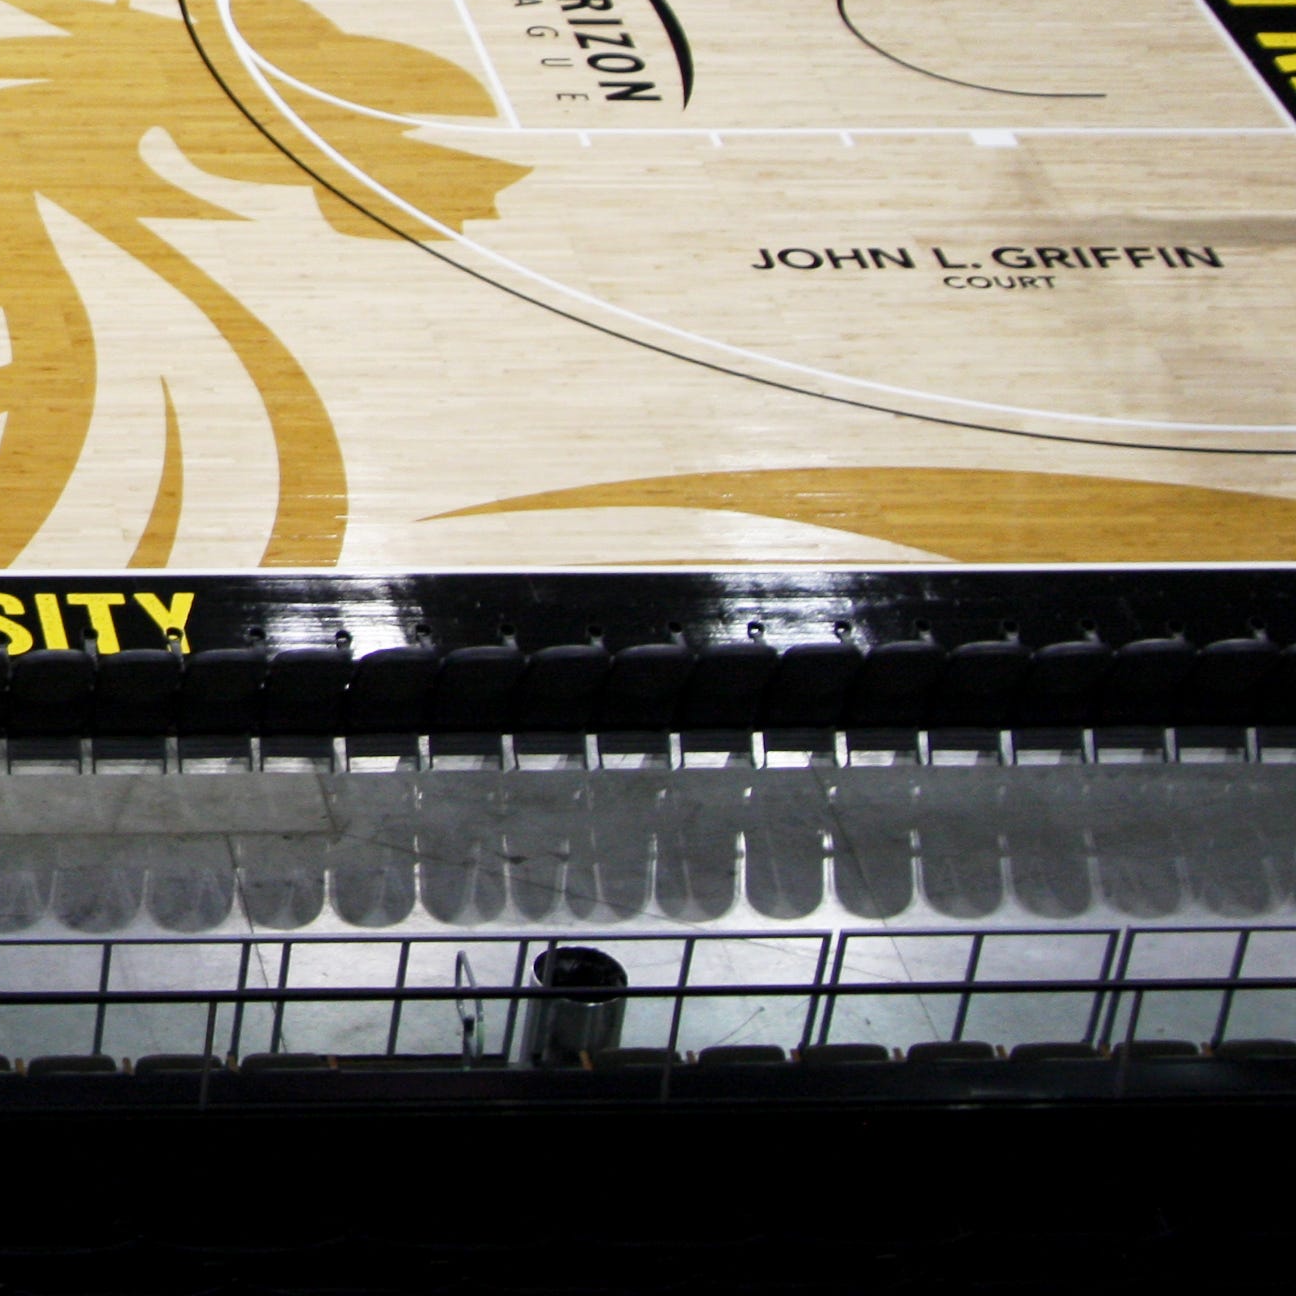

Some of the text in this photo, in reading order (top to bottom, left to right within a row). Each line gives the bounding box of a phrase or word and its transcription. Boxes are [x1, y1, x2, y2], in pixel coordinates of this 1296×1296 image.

[751, 246, 1225, 270] JOHN L. GRIFFIN
[942, 274, 1057, 290] COURT
